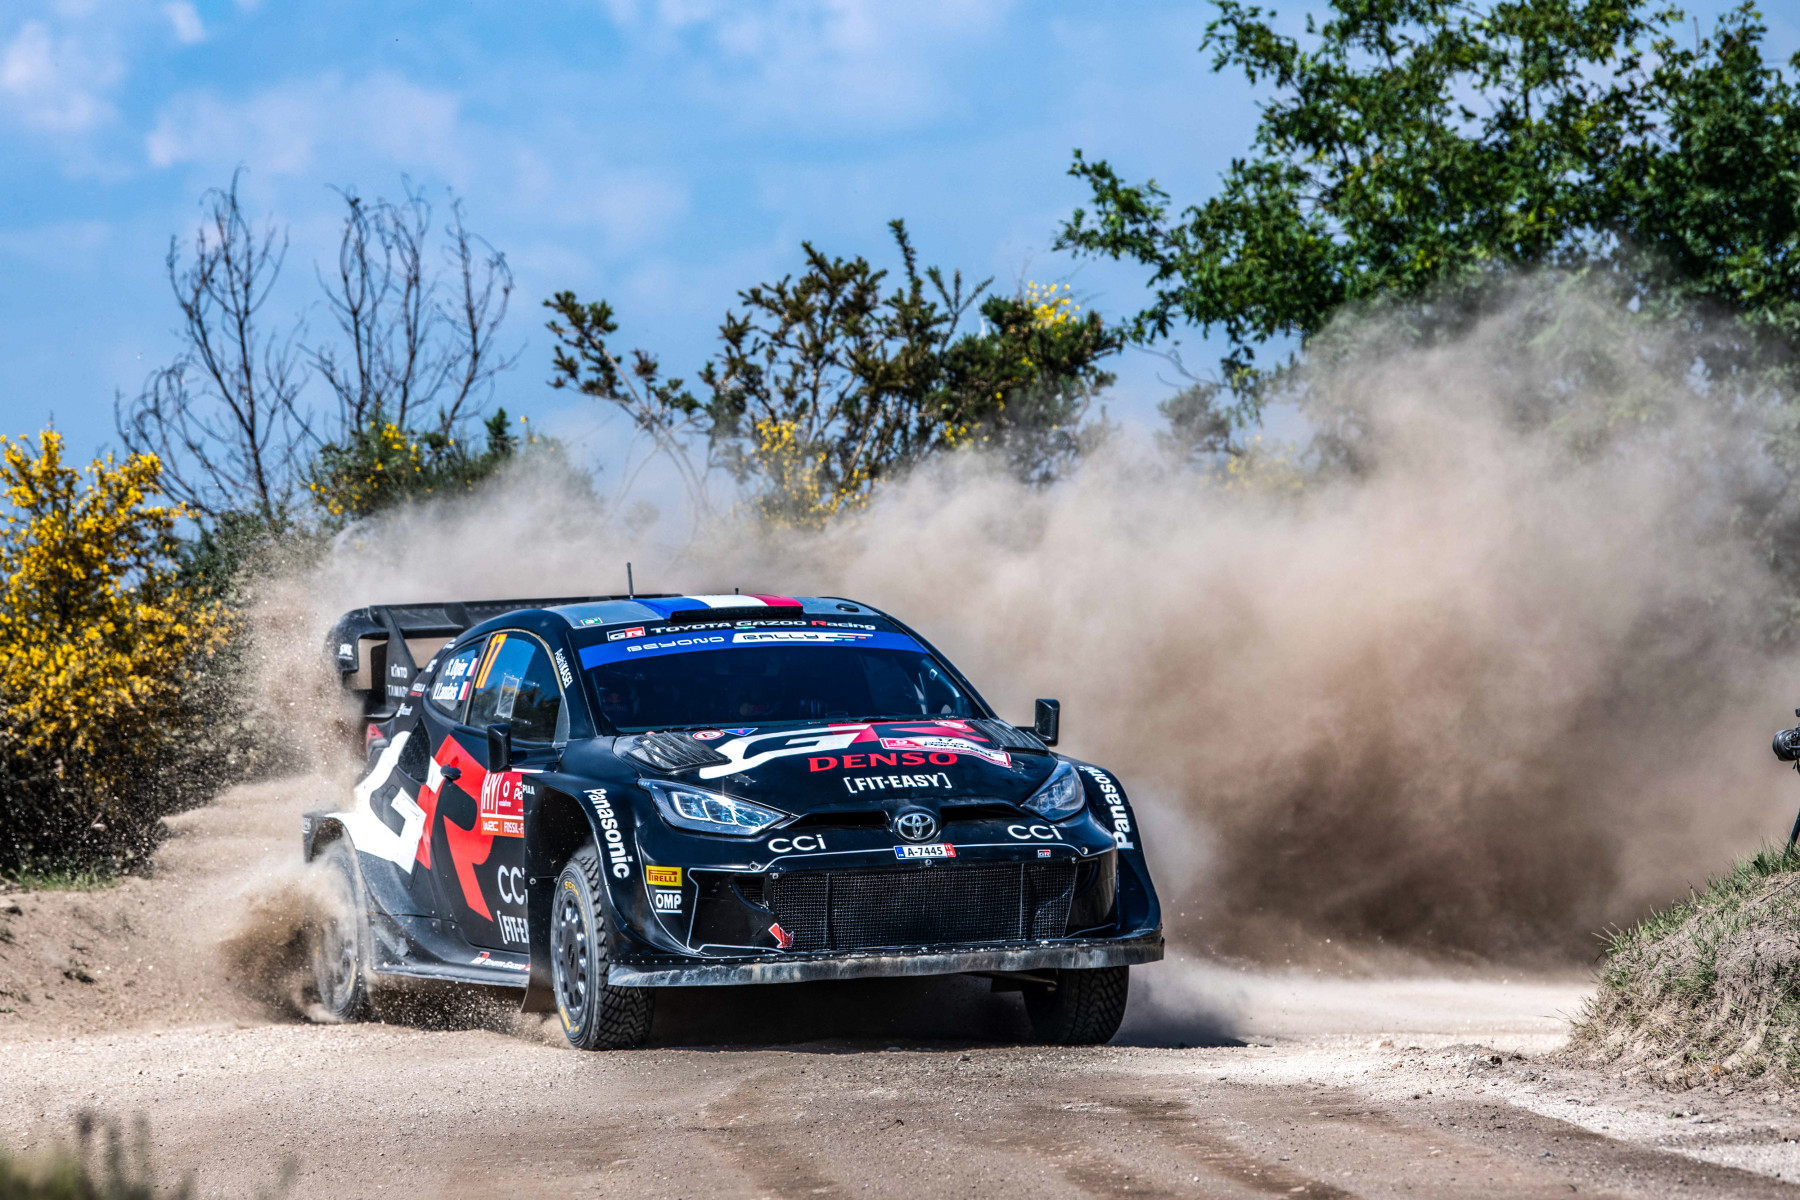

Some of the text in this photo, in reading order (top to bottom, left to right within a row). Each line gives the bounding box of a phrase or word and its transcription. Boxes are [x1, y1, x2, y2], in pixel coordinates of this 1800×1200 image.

[609, 629, 644, 640] GR
[650, 622, 731, 633] TOYOTA
[811, 620, 876, 631] Racing
[626, 633, 820, 652] BEYOND RALLY
[475, 634, 508, 689] 17
[808, 751, 958, 772] DENSO
[523, 784, 536, 795] PIAA
[583, 788, 634, 879] Panasonic
[907, 846, 944, 857] A-7445
[648, 869, 678, 883] PIRELLI
[655, 894, 682, 909] OMP
